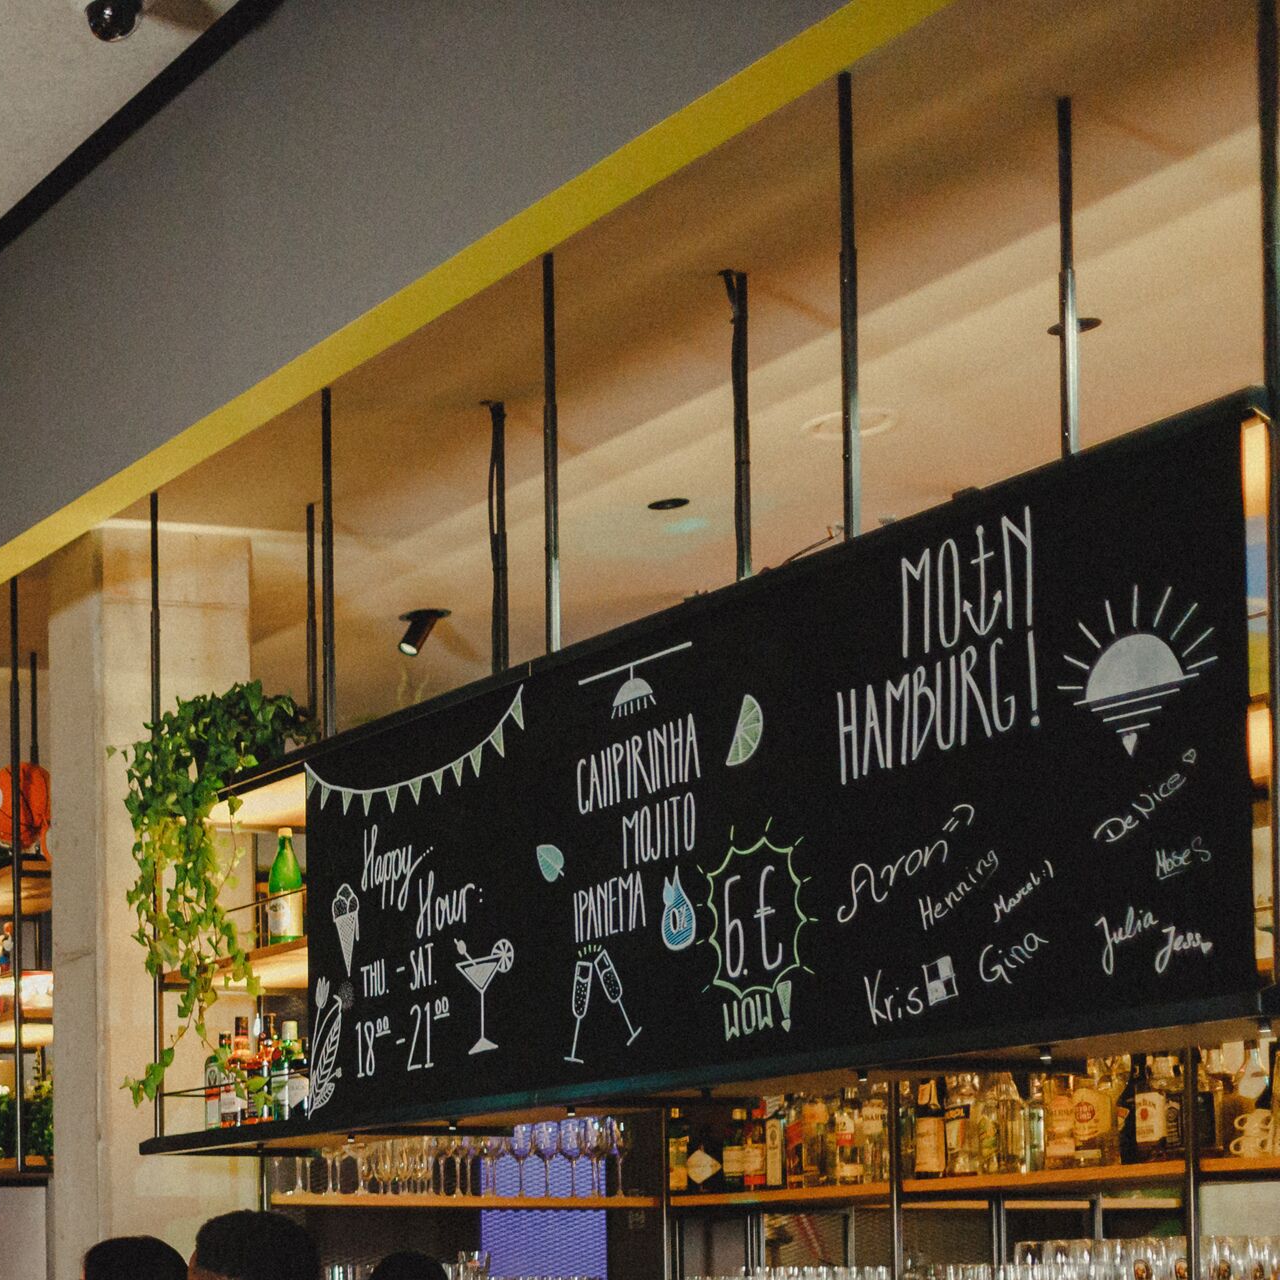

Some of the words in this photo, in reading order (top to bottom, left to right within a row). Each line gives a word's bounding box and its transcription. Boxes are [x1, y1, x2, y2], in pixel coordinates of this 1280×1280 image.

[837, 630, 1040, 785] HAMBURG!
[622, 792, 696, 869] MOJITO
[416, 870, 483, 939] Hour:
[573, 871, 646, 943] IPANEMA
[918, 850, 999, 931] Henning
[979, 932, 1049, 984] Gina
[1095, 906, 1159, 975] Julia
[1155, 926, 1202, 974] Jess
[360, 958, 389, 997] THU.
[864, 969, 923, 1026] Kris
